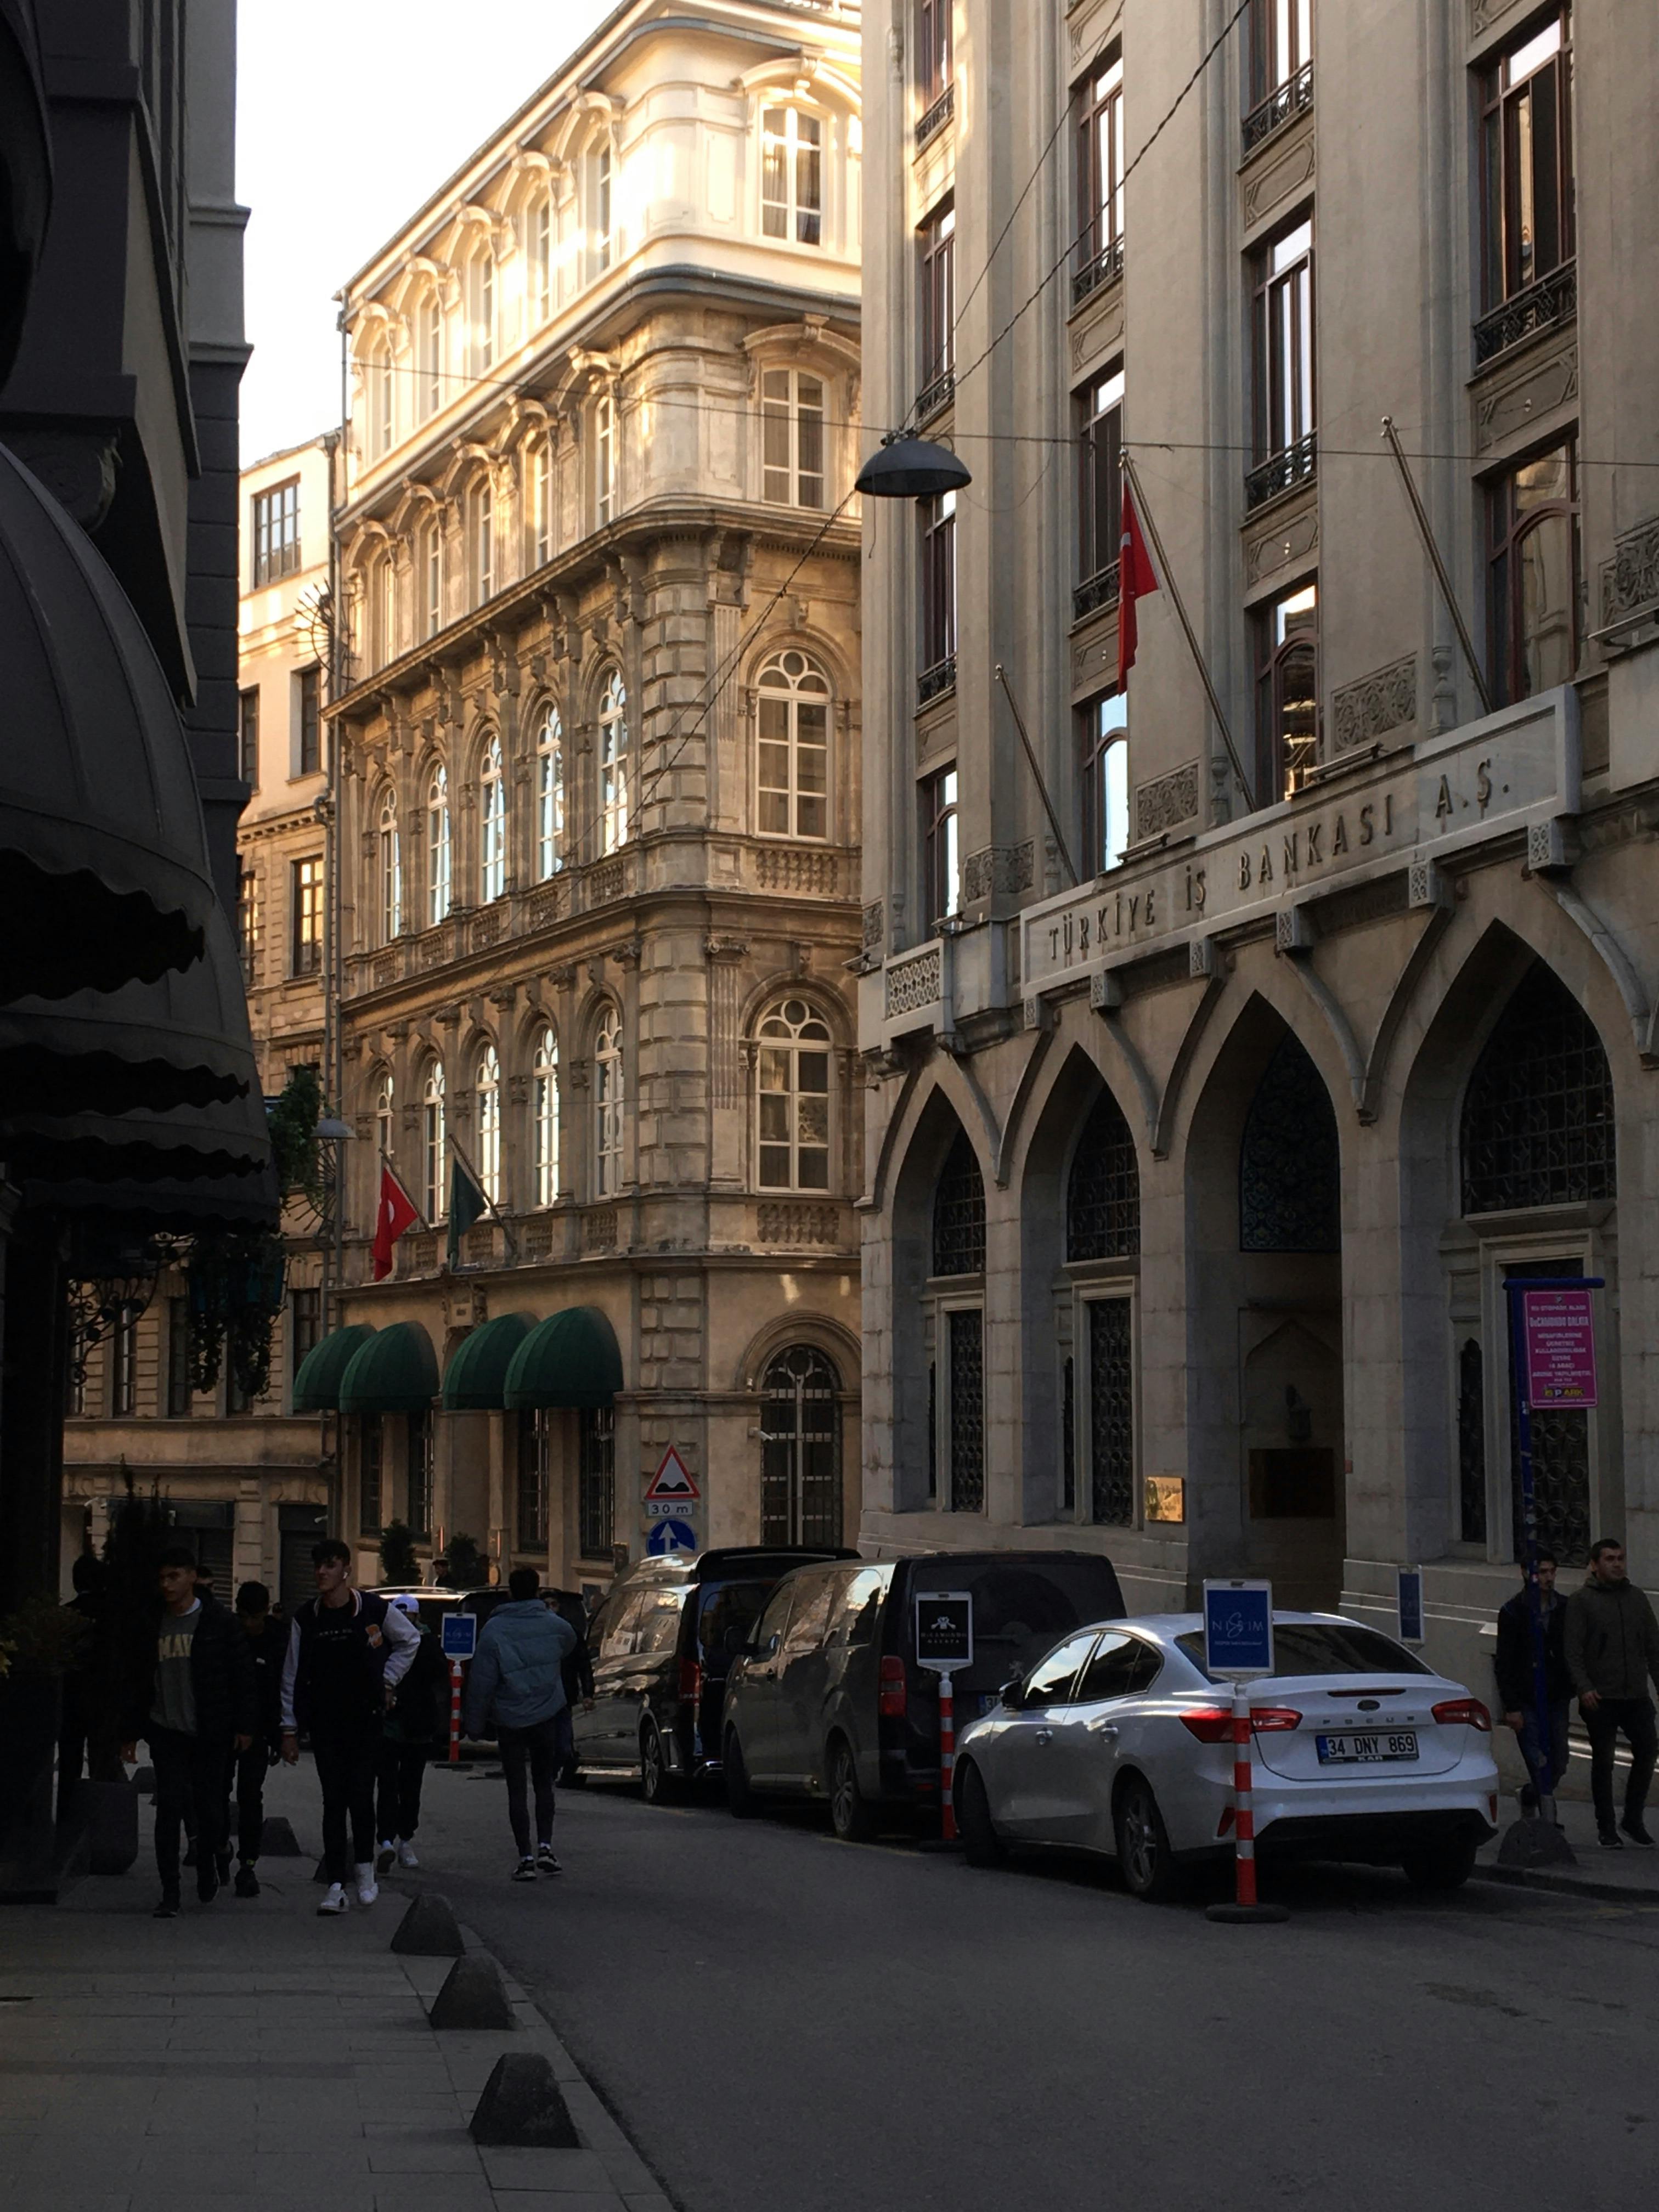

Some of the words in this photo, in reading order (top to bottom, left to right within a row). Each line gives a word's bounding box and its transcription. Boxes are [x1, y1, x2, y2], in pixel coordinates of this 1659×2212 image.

[1048, 890, 1155, 960] TÜRKİYE
[1185, 865, 1206, 912] İŞ
[1238, 794, 1392, 891] BANKASI
[652, 1504, 670, 1514] 30
[1328, 1739, 1346, 1756] 34
[1354, 1737, 1379, 1754] DNY
[1389, 1735, 1414, 1753] 869
